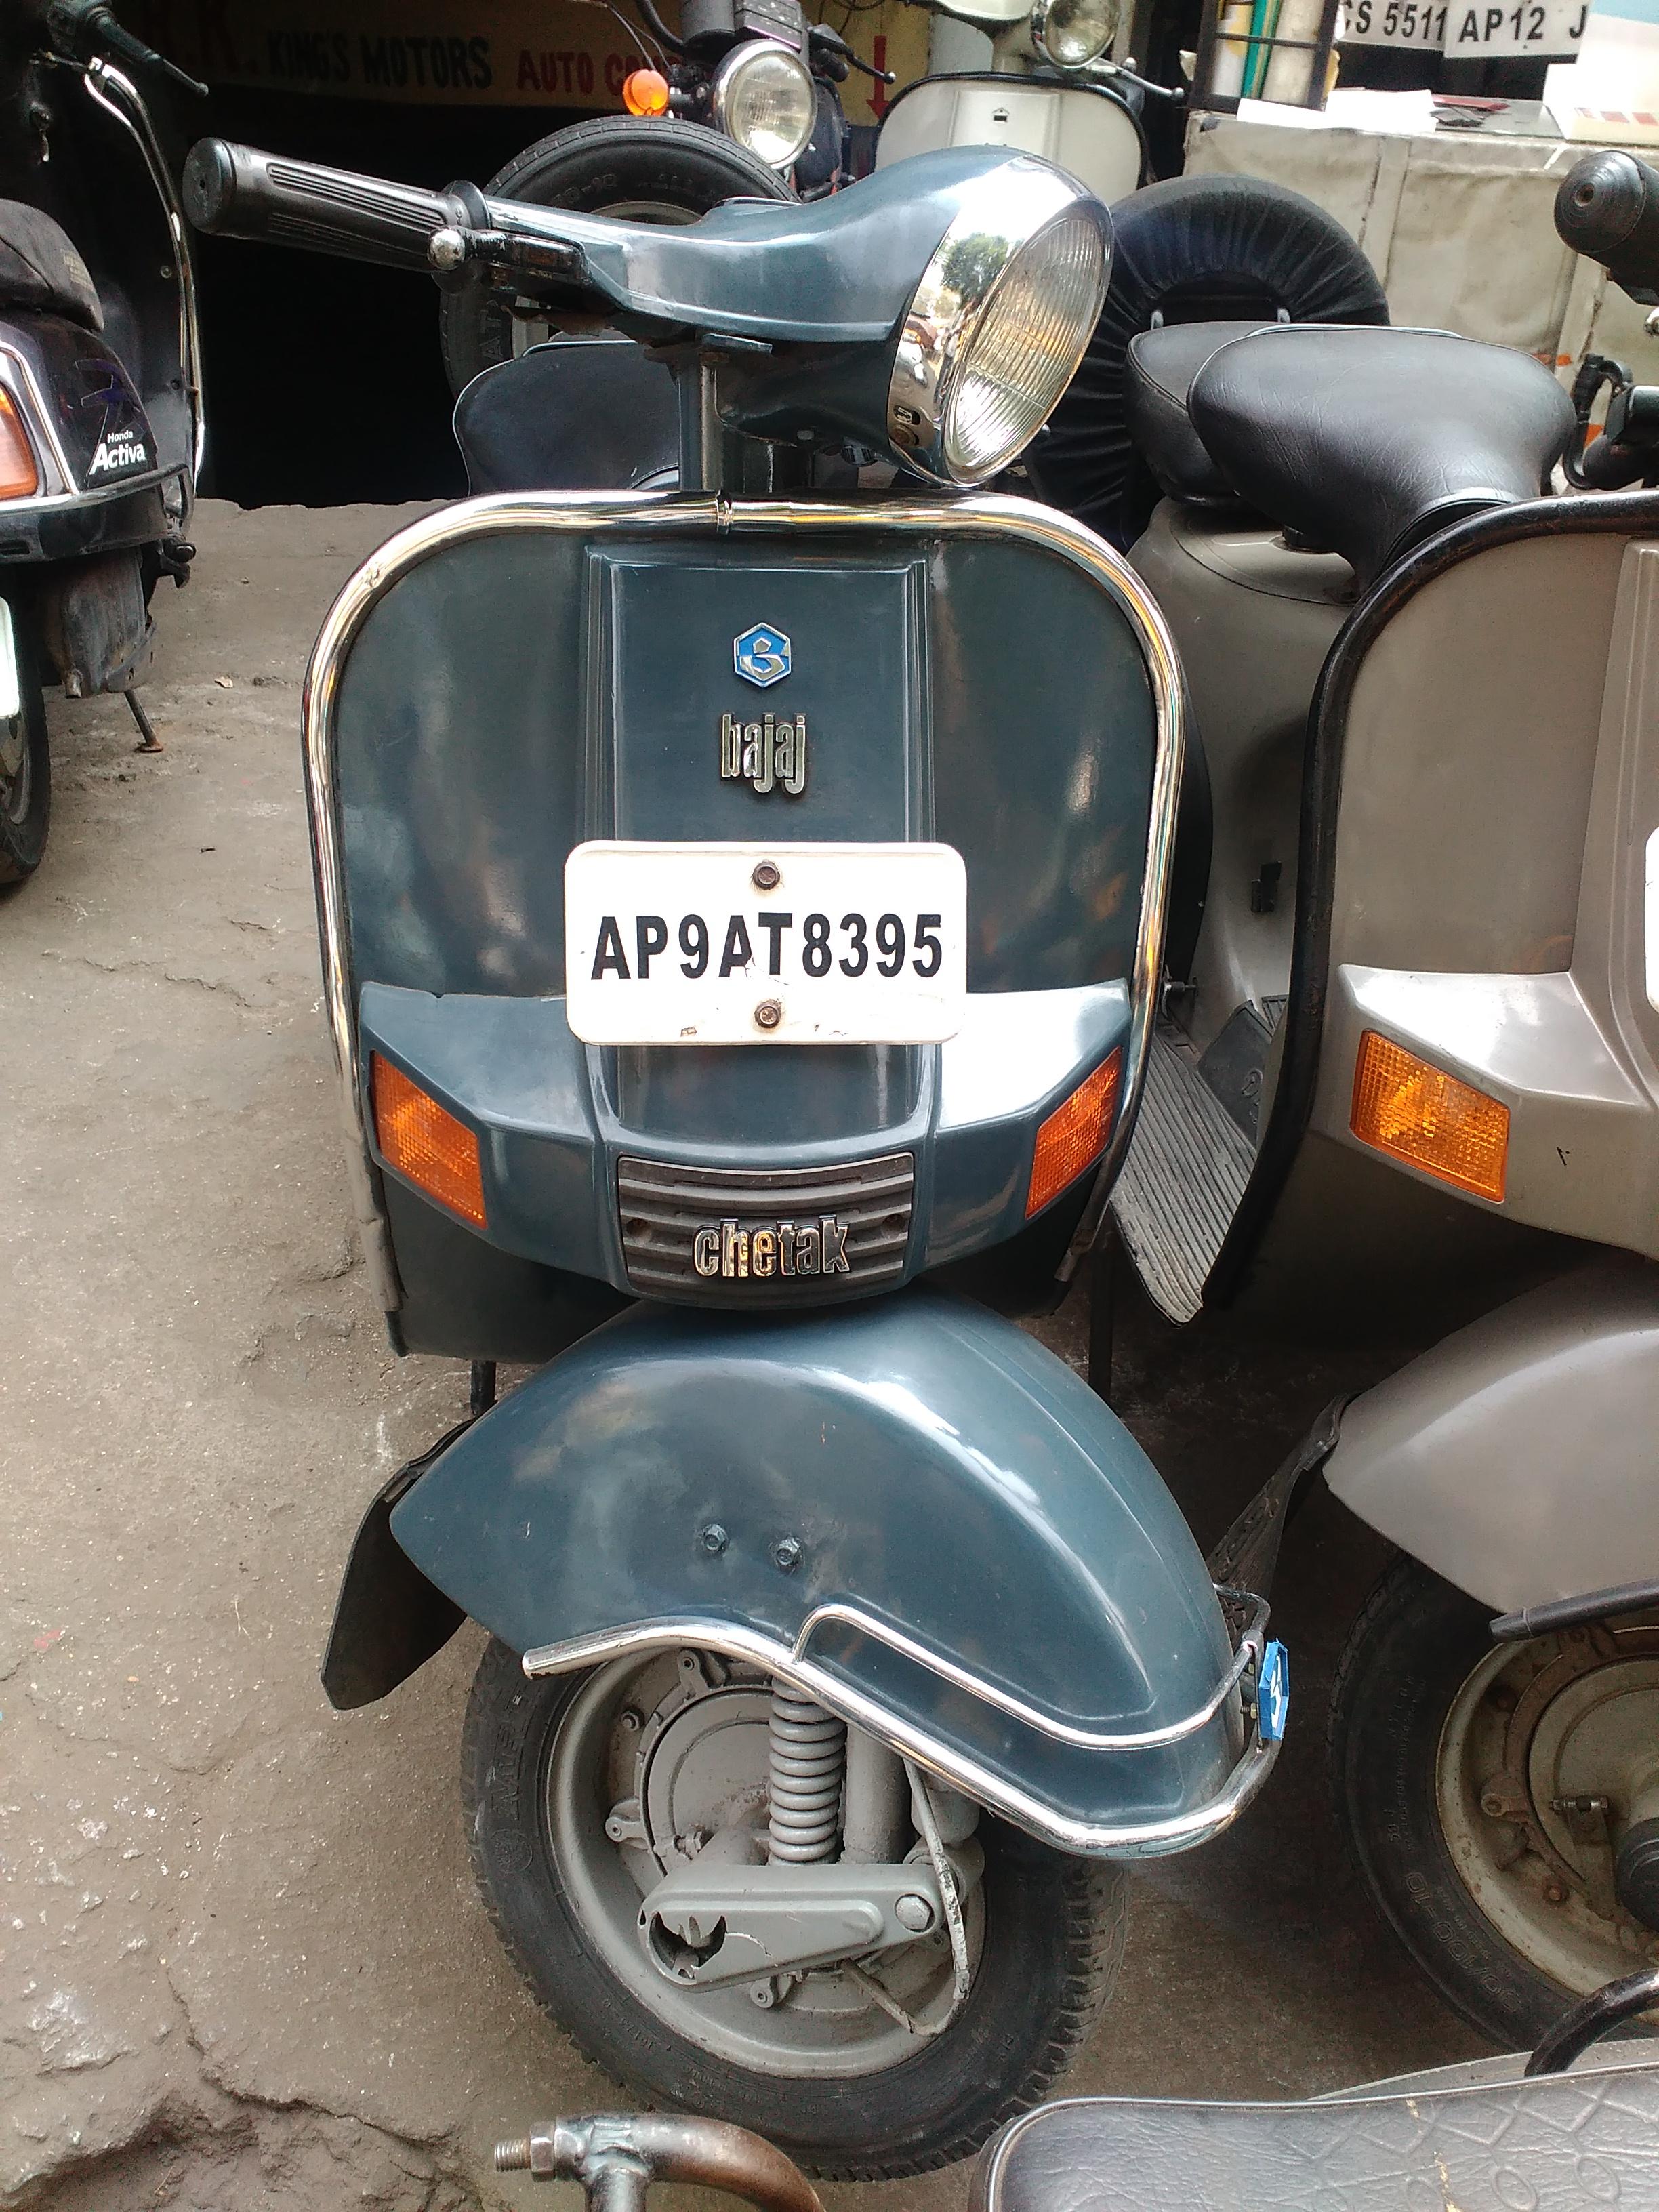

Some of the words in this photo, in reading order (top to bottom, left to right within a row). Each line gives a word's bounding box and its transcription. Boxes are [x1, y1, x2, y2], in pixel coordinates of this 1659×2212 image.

[1383, 1, 1446, 41] 5511
[1458, 7, 1546, 43] AP12
[1569, 4, 1588, 39] J
[359, 34, 493, 90] MOTORS
[516, 49, 594, 96] AUTO
[89, 442, 147, 475] Activa
[107, 430, 134, 443] Honda
[720, 712, 807, 794] bajaj
[591, 912, 943, 980] AP9AT8395
[693, 1215, 851, 1278] chetak
